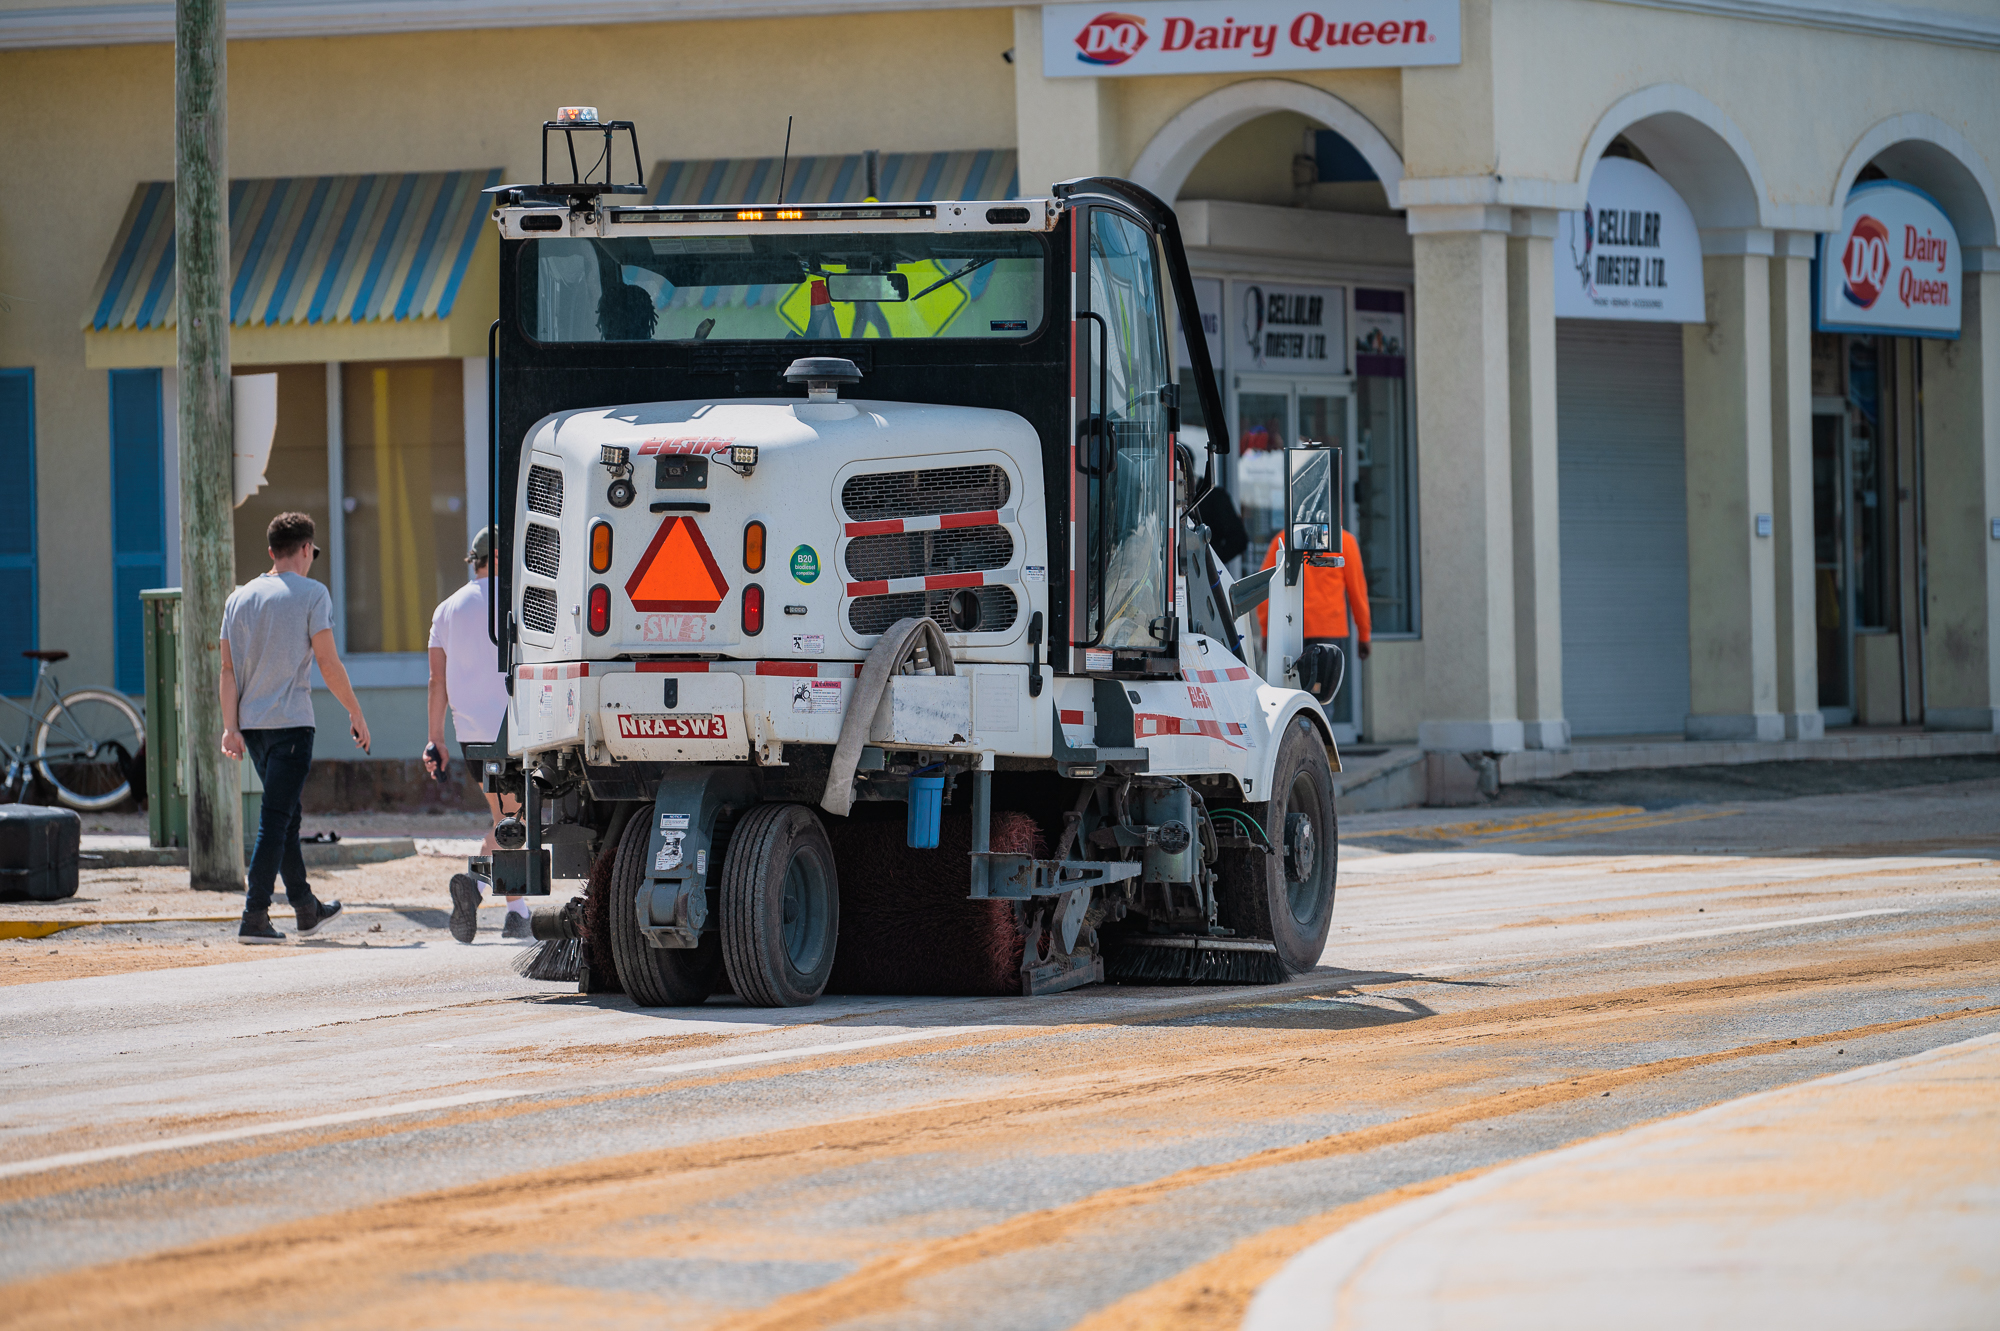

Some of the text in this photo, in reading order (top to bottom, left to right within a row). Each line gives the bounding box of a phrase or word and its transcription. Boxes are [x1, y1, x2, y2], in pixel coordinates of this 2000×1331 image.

[1084, 23, 1139, 55] DQ
[1160, 11, 1428, 58] Dairy Queen
[1598, 208, 1661, 249] CELLULAR
[1850, 235, 1885, 293] DQ
[1903, 223, 1947, 274] Dairy
[1596, 254, 1668, 288] MASTER LTD.
[1898, 265, 1949, 310] Queen
[1268, 293, 1323, 327] CELLULAR
[1265, 332, 1304, 359] MASTER
[637, 437, 736, 456] ELGIN
[797, 554, 813, 563] B20
[647, 616, 704, 640] SW 3
[620, 716, 725, 736] NRA-SW3
